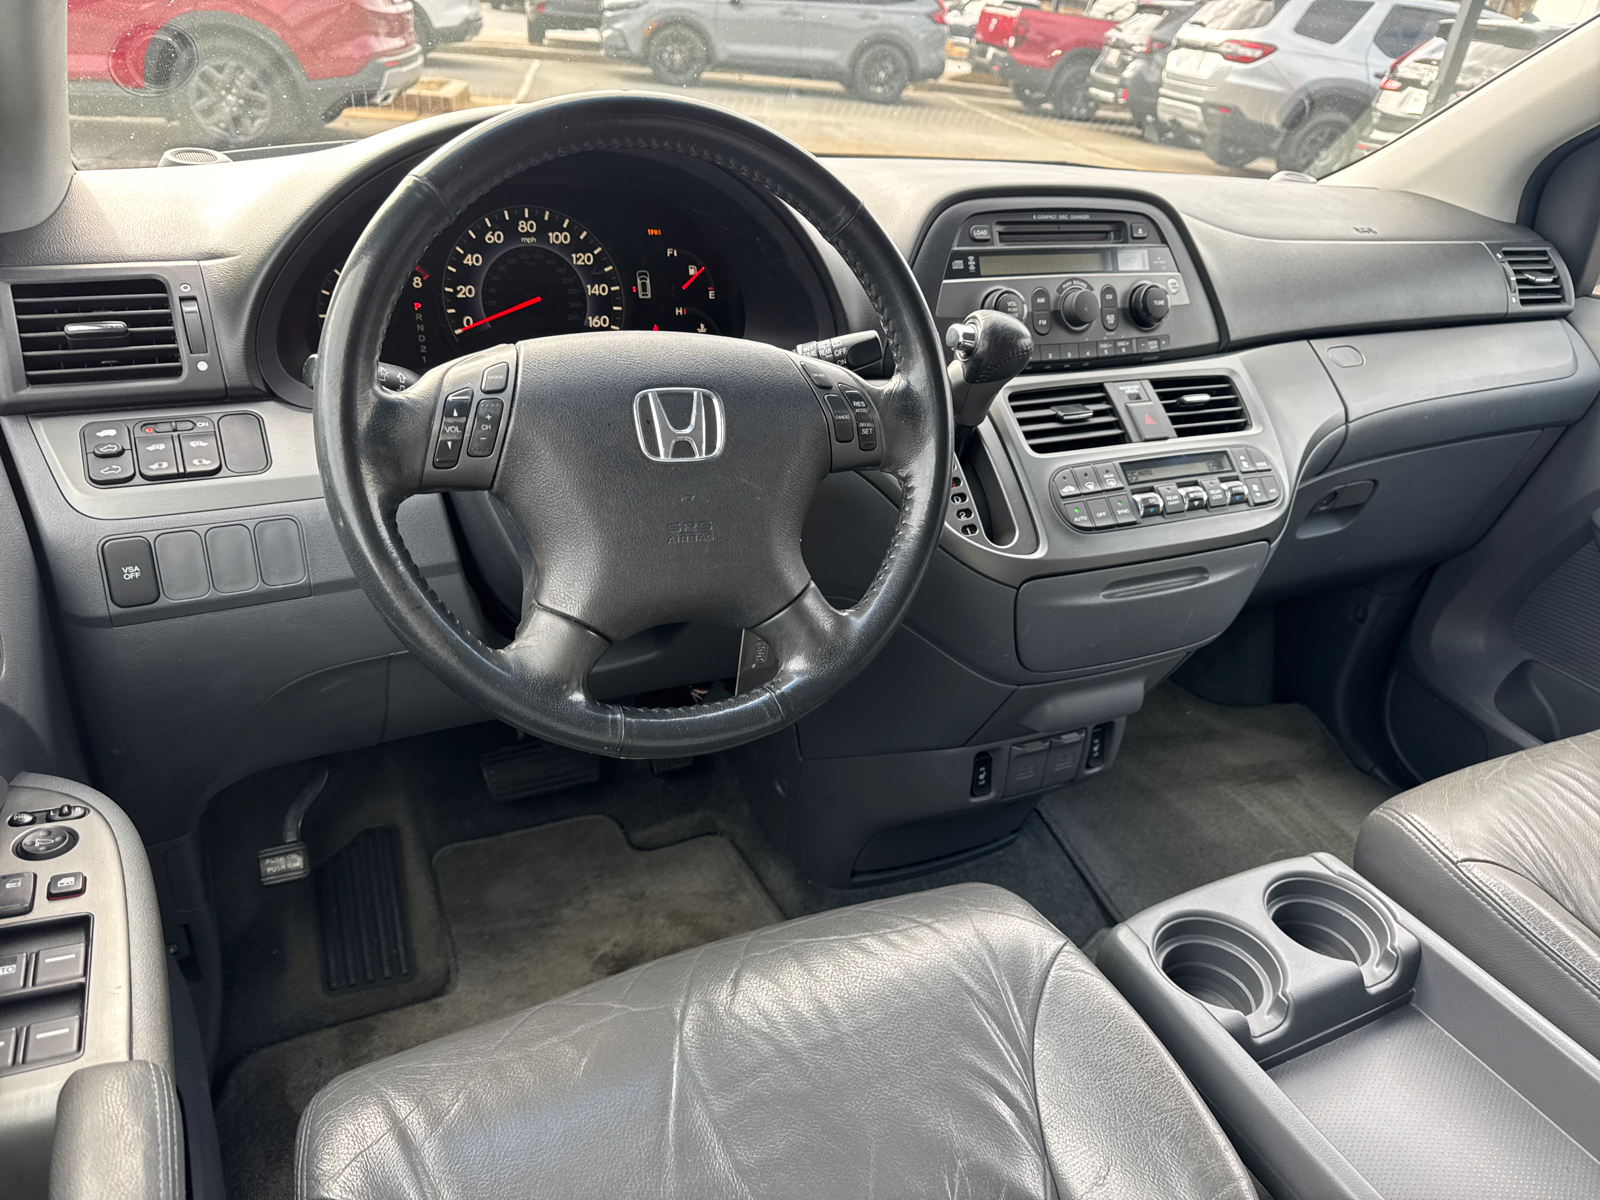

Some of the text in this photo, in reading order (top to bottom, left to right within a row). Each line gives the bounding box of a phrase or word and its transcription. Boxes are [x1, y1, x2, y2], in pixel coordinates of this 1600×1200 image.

[518, 220, 537, 233] 80
[485, 231, 504, 244] 60
[521, 236, 537, 244] mph
[548, 231, 571, 245] 100
[667, 248, 673, 257] F
[463, 253, 482, 266] 40
[571, 253, 593, 265] 120
[412, 276, 423, 289] 8
[456, 285, 475, 298] 20
[586, 284, 609, 296] 140
[708, 290, 715, 299] E
[413, 302, 422, 311] P
[675, 307, 683, 316] H
[415, 313, 423, 321] R
[587, 315, 610, 328] 160
[463, 316, 473, 328] 0
[418, 334, 426, 342] D
[420, 345, 427, 353] 2
[834, 347, 847, 357] OFF
[836, 358, 847, 366] ON
[481, 423, 492, 431] CH
[953, 496, 962, 504] D
[960, 511, 967, 519] 2
[667, 521, 713, 533] SRS
[667, 532, 714, 544] AIRBAG
[121, 566, 141, 574] VSA
[123, 572, 141, 580] OFF
